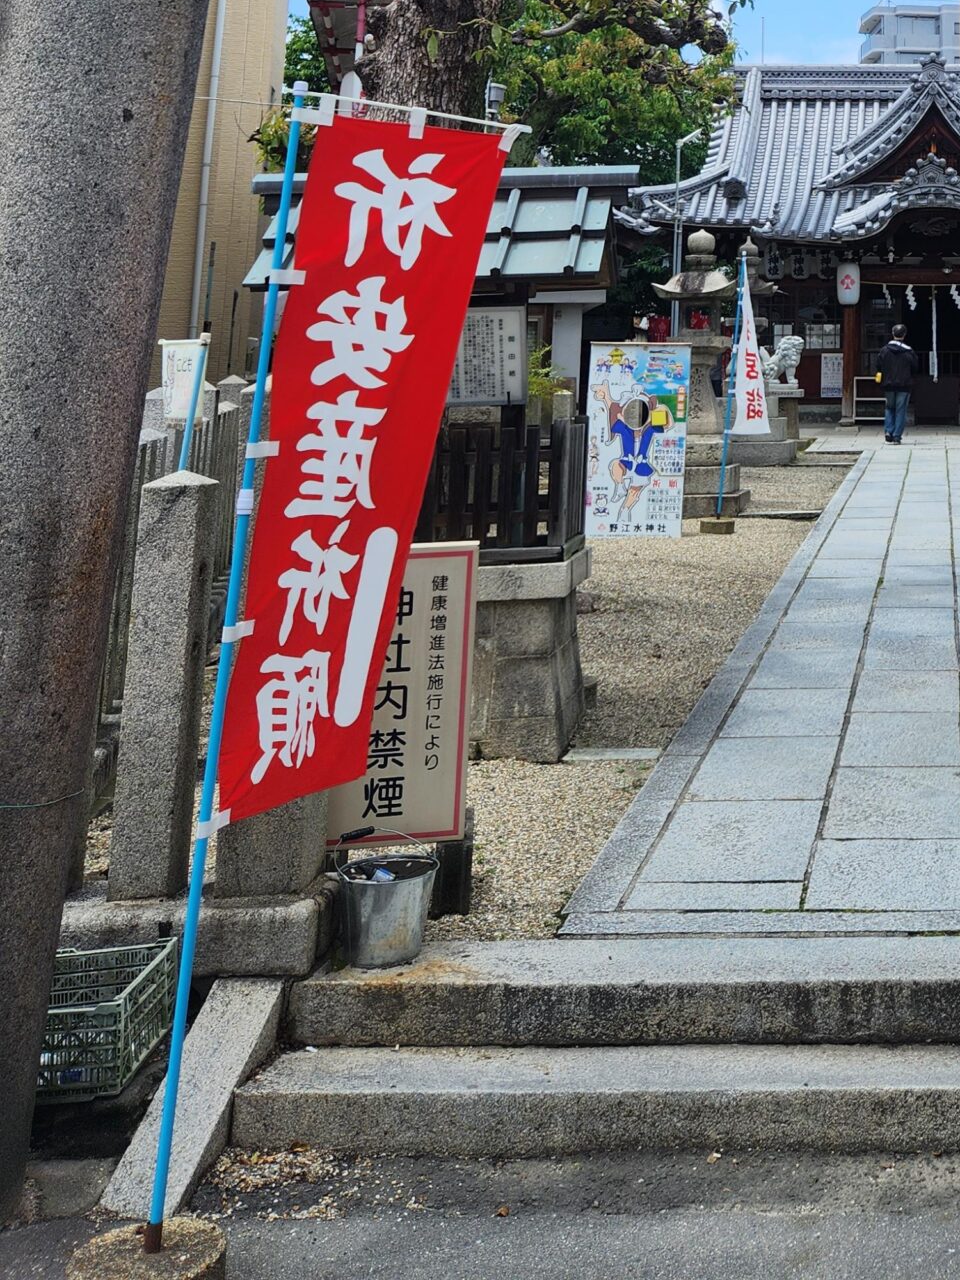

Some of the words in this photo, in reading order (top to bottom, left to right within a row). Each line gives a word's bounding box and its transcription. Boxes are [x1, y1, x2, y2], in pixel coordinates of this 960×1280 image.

[609, 523, 666, 533] 野江水神社
[424, 575, 449, 771] 健康増進法施行により
